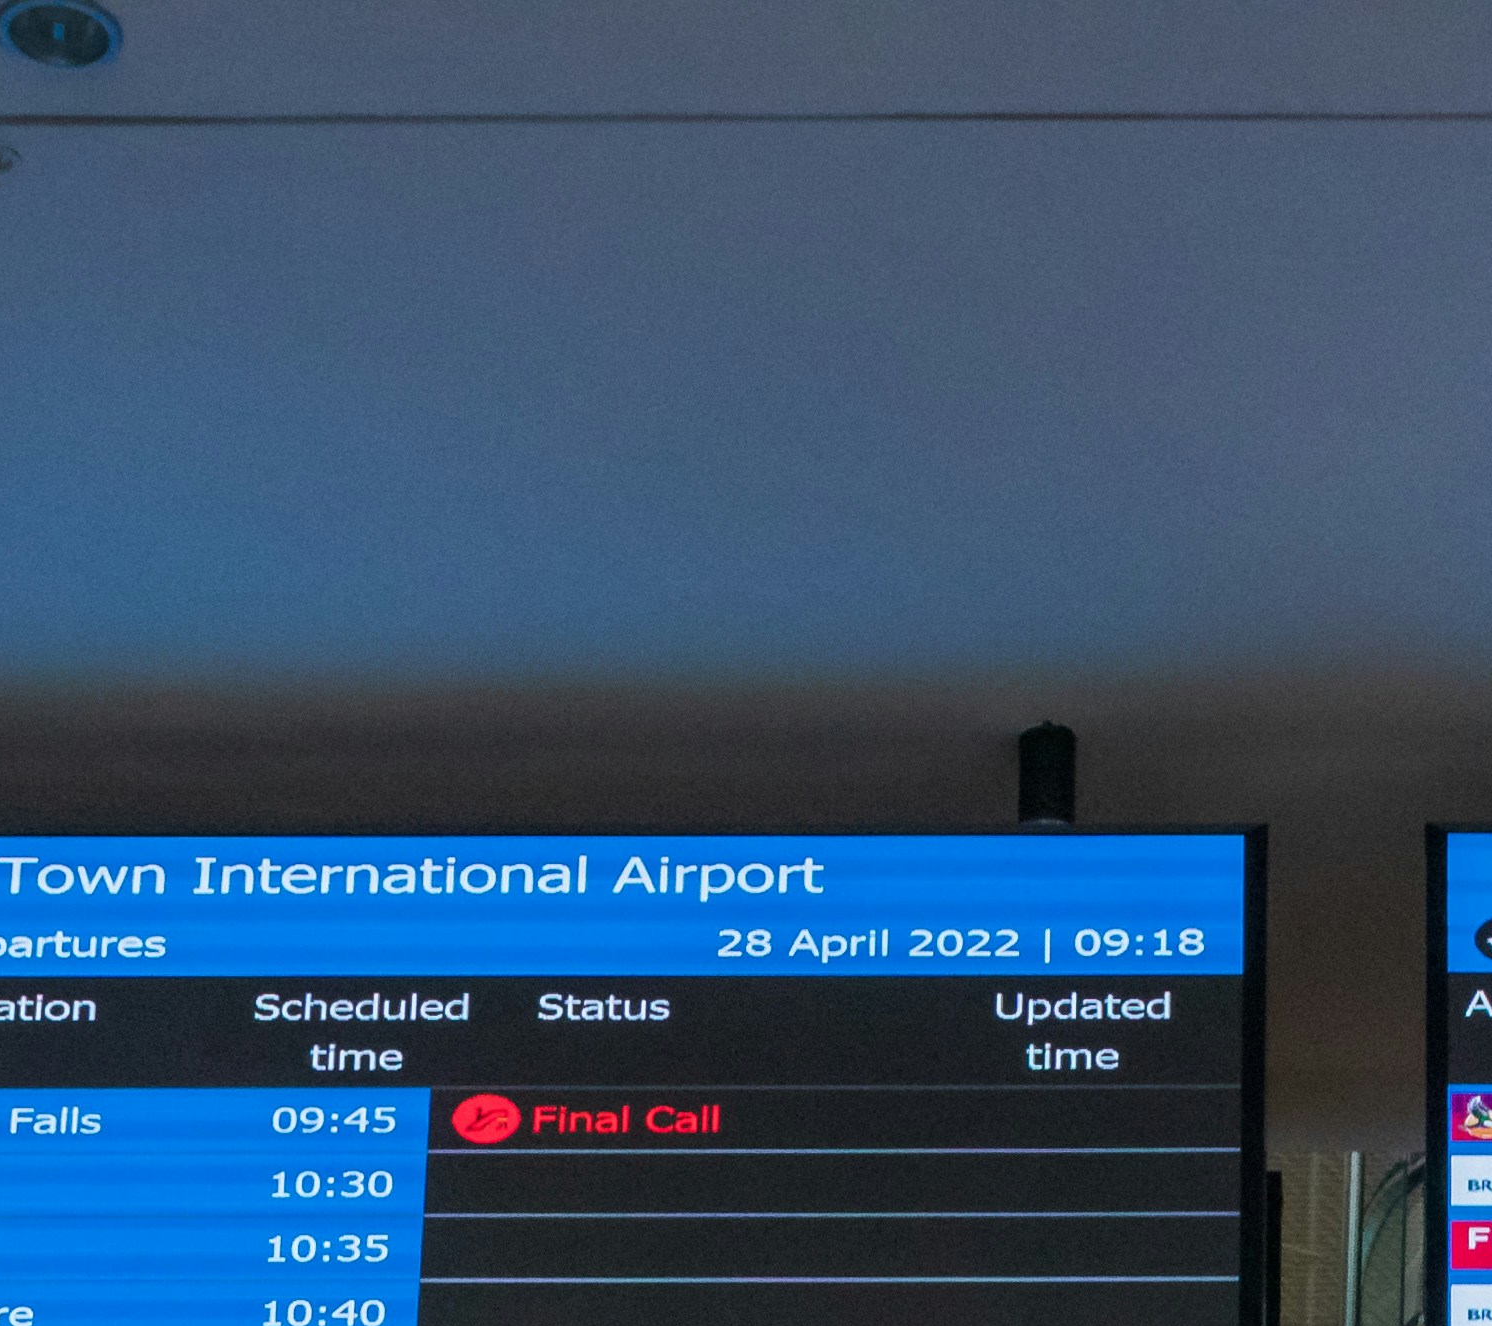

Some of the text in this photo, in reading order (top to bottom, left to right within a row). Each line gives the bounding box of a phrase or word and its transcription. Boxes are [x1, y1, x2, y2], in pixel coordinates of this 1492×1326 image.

[194, 856, 586, 893] International
[614, 857, 823, 901] Airport
[718, 930, 771, 956] 28
[789, 930, 888, 962] April
[910, 930, 1019, 956] 2022
[1075, 929, 1204, 956] 09:18
[255, 993, 469, 1020] Scheduled
[539, 994, 669, 1020] Status
[996, 991, 1170, 1025] Updated
[311, 1044, 402, 1070] time
[1027, 1043, 1119, 1069] time
[11, 1107, 100, 1133] Falls
[273, 1108, 395, 1132] 09:45
[533, 1105, 630, 1133] Final
[646, 1105, 720, 1133] Call
